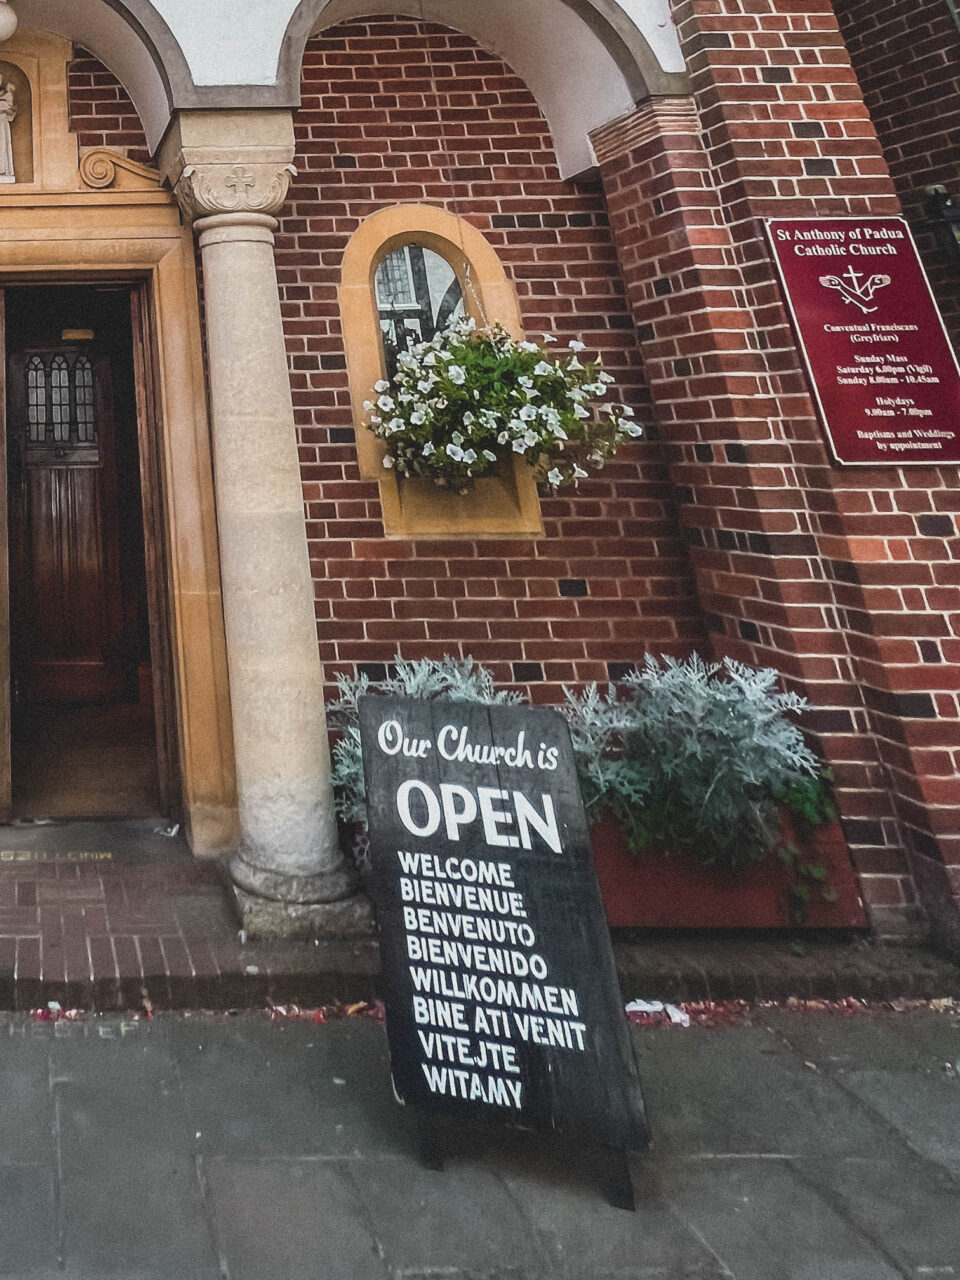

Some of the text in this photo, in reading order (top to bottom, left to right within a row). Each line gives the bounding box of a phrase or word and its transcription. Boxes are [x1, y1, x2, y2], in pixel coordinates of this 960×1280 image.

[777, 228, 904, 242] St Anthony of Padua
[794, 243, 897, 256] Catholic Church
[824, 324, 918, 332] Conventual Franciscans
[850, 334, 899, 343] (Greyfriars)
[836, 365, 874, 375] Saturday
[906, 364, 933, 374] (Vigil)
[854, 354, 908, 364] Sunday Mass
[836, 376, 867, 385] Sunday
[905, 376, 939, 384] 10.45am
[875, 397, 915, 407] Holydays
[856, 429, 956, 440] Baptisms and Weddings
[876, 441, 942, 451] by appointment
[378, 720, 559, 770] Our Church is
[396, 779, 563, 854] OPEN
[397, 851, 515, 888] WELCOME
[400, 877, 528, 918] BIENVENUE
[402, 906, 535, 947] BENVENUTO
[406, 934, 548, 980] BIENVENIDO
[409, 966, 579, 1017] WILLKOMMEN
[413, 995, 586, 1051] BINE ATI VENIT
[417, 1030, 520, 1073] VITEJTE
[421, 1063, 522, 1109] WITAMY
